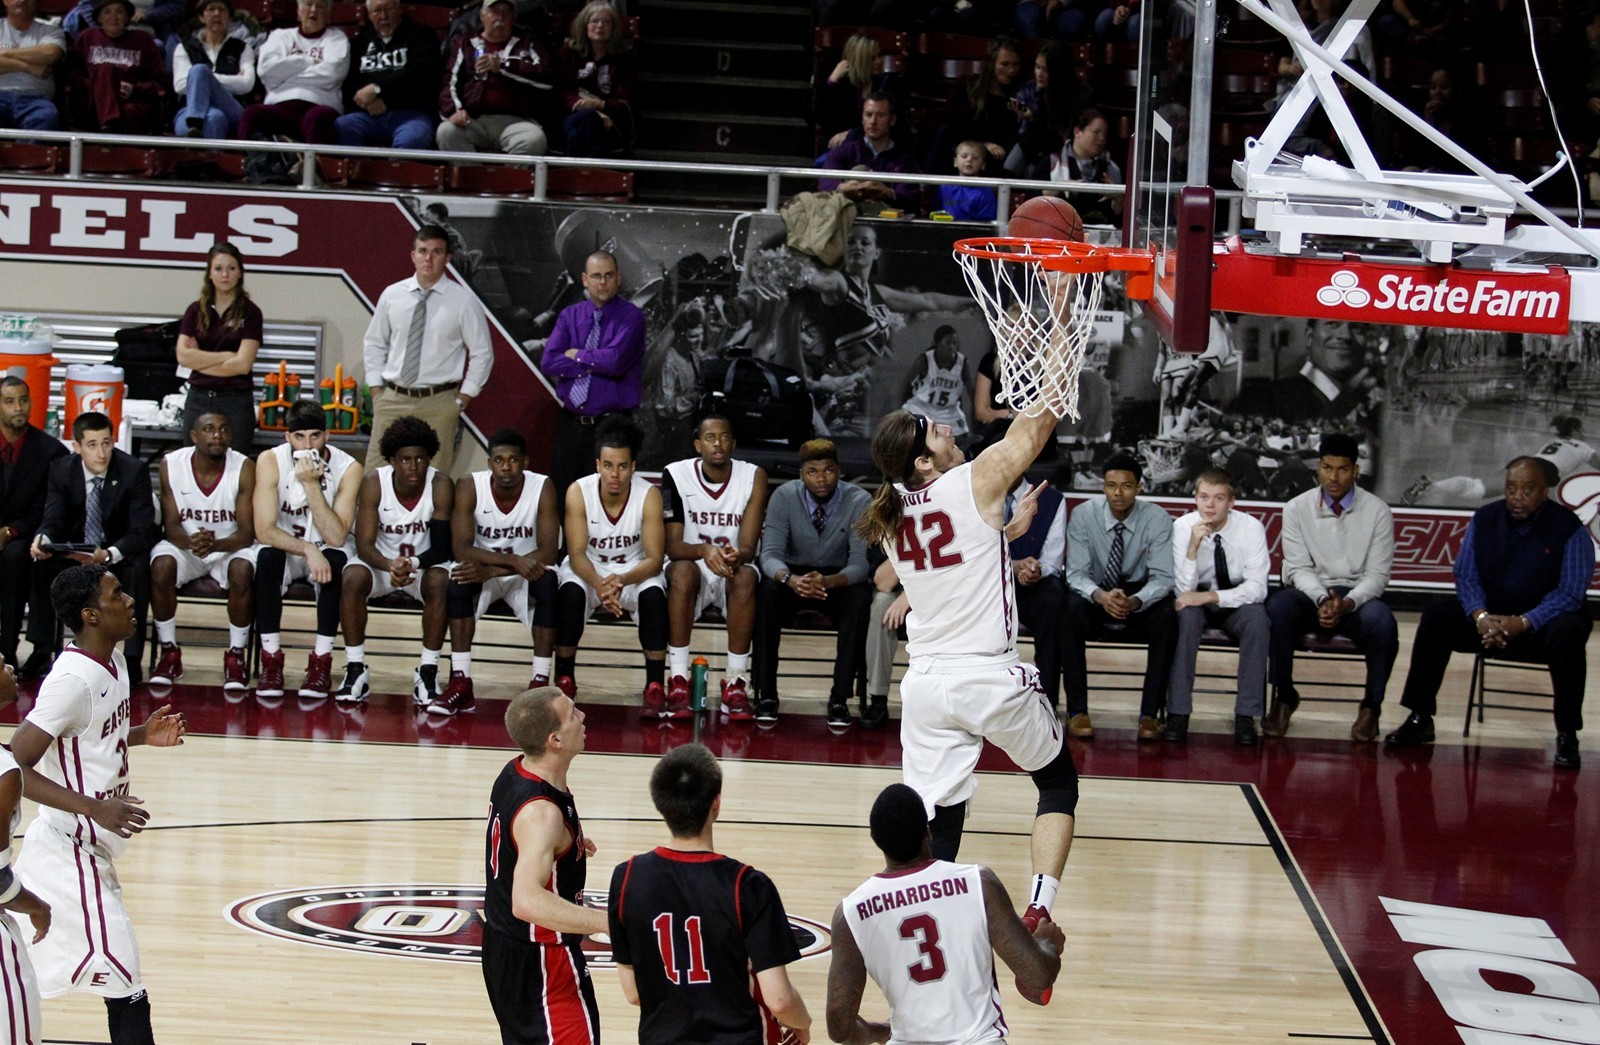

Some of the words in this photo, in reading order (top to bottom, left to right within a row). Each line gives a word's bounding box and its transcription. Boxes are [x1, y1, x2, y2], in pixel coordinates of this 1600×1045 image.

[360, 48, 408, 72] EKU
[716, 126, 731, 146] C
[179, 508, 237, 523] EASTERN
[477, 525, 533, 538] EASTERN
[588, 534, 640, 549] ASTERN
[897, 508, 965, 572] 42
[856, 877, 969, 921] RICHARDSON
[652, 912, 712, 985] 11
[897, 911, 949, 986] 3
